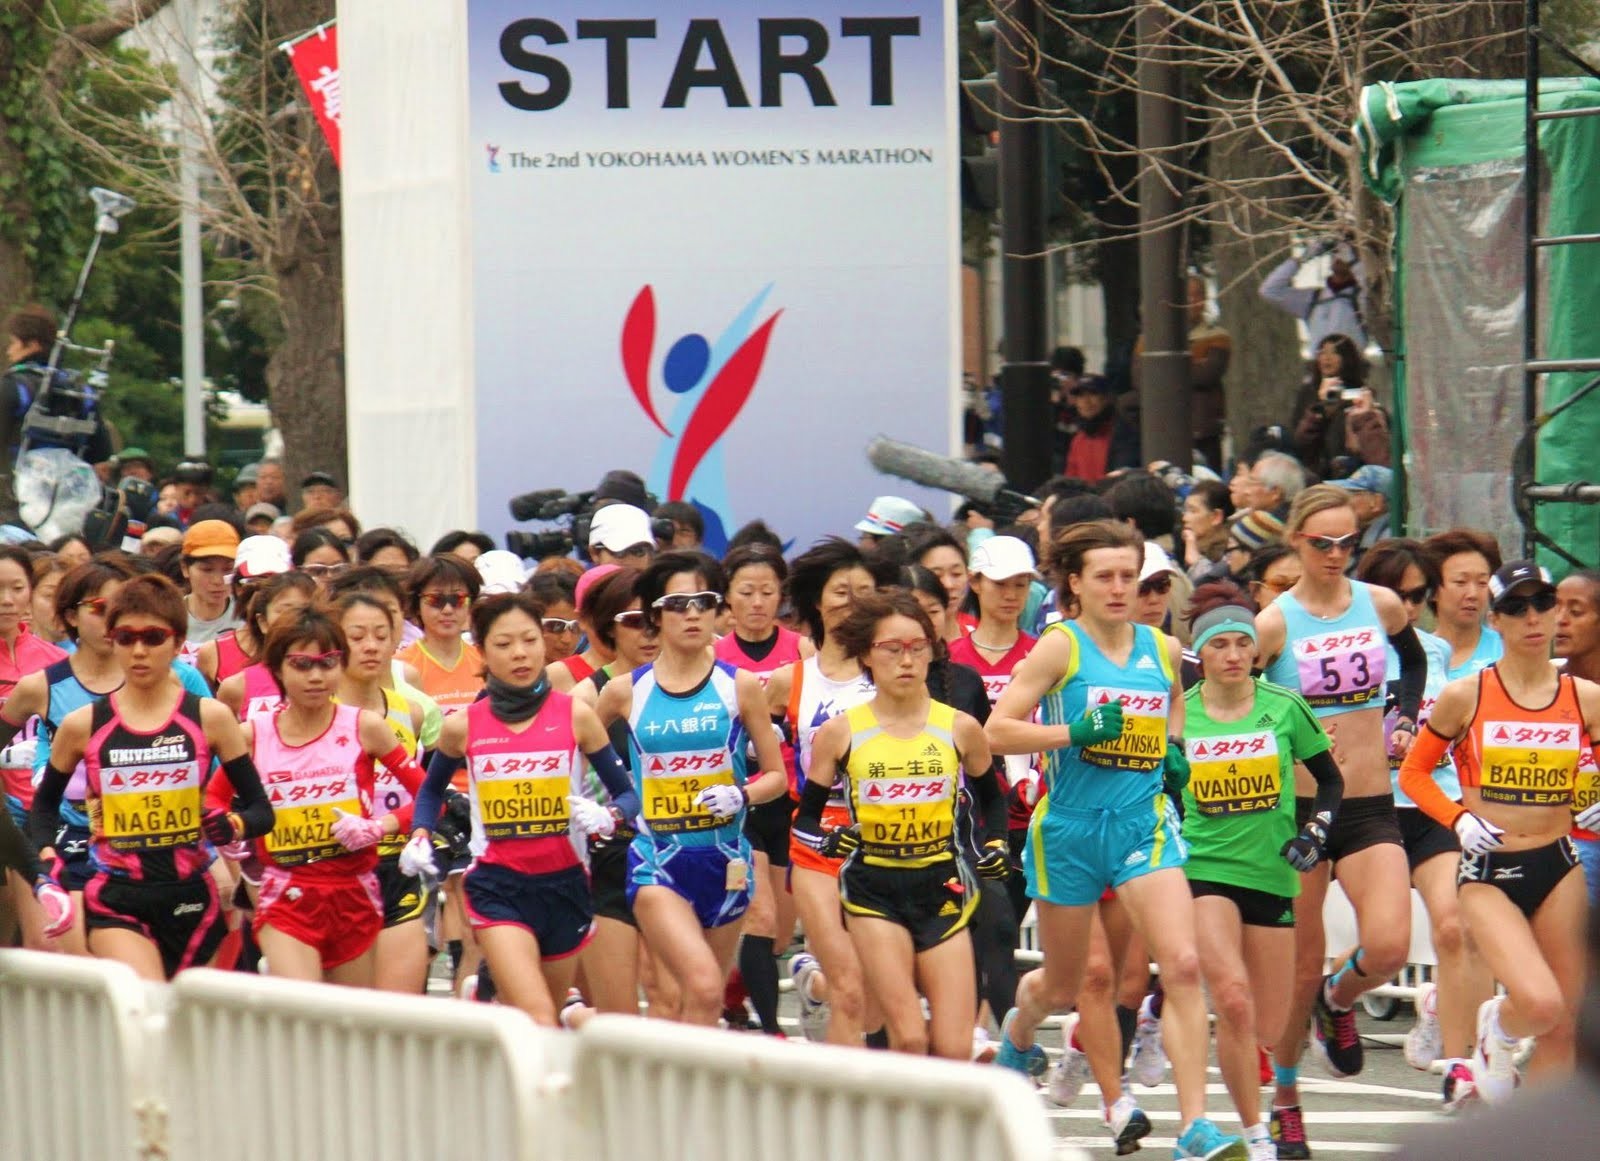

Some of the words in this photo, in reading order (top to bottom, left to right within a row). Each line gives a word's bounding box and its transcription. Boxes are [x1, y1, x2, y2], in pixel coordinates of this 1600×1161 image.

[498, 16, 921, 111] START
[508, 152, 541, 168] The
[546, 151, 579, 168] 2nd
[586, 150, 707, 168] YOKOHAMA
[712, 149, 810, 166] WOMEN'S
[817, 148, 933, 165] MARATHON
[1321, 630, 1375, 652] タケダ
[1320, 652, 1370, 692] 53
[1341, 687, 1378, 704] LEF
[644, 715, 718, 736] 十八銀行
[1125, 718, 1135, 731] 5
[1090, 733, 1161, 754] RZYNSKA
[1515, 727, 1574, 744] タケダ
[109, 744, 189, 763] UNIVERSAL
[1212, 735, 1268, 756] タケダ
[501, 753, 565, 774] タケダ
[668, 749, 727, 772] タケダ
[1529, 752, 1538, 765] 3
[130, 765, 191, 787] タケダ
[868, 759, 943, 778] 第一生命
[1228, 763, 1238, 776] 4
[1490, 765, 1568, 788] BARROS
[289, 776, 349, 802] タケダ
[513, 782, 533, 795] 13
[680, 779, 700, 792] 12
[886, 779, 946, 799] タケダ
[1193, 773, 1275, 799] IVANOVA
[142, 795, 162, 809] 15
[1228, 797, 1278, 812] LEAF
[1522, 793, 1569, 803] LEAF
[302, 808, 321, 822] 14
[484, 796, 565, 820] YOSHIDA
[899, 807, 916, 820] 11
[113, 807, 192, 832] NAGAO
[516, 822, 567, 835] LEAF
[685, 816, 733, 830] LEAF
[145, 831, 199, 848] LEAF
[874, 820, 941, 842] OZAKI
[900, 840, 948, 857] LEAF
